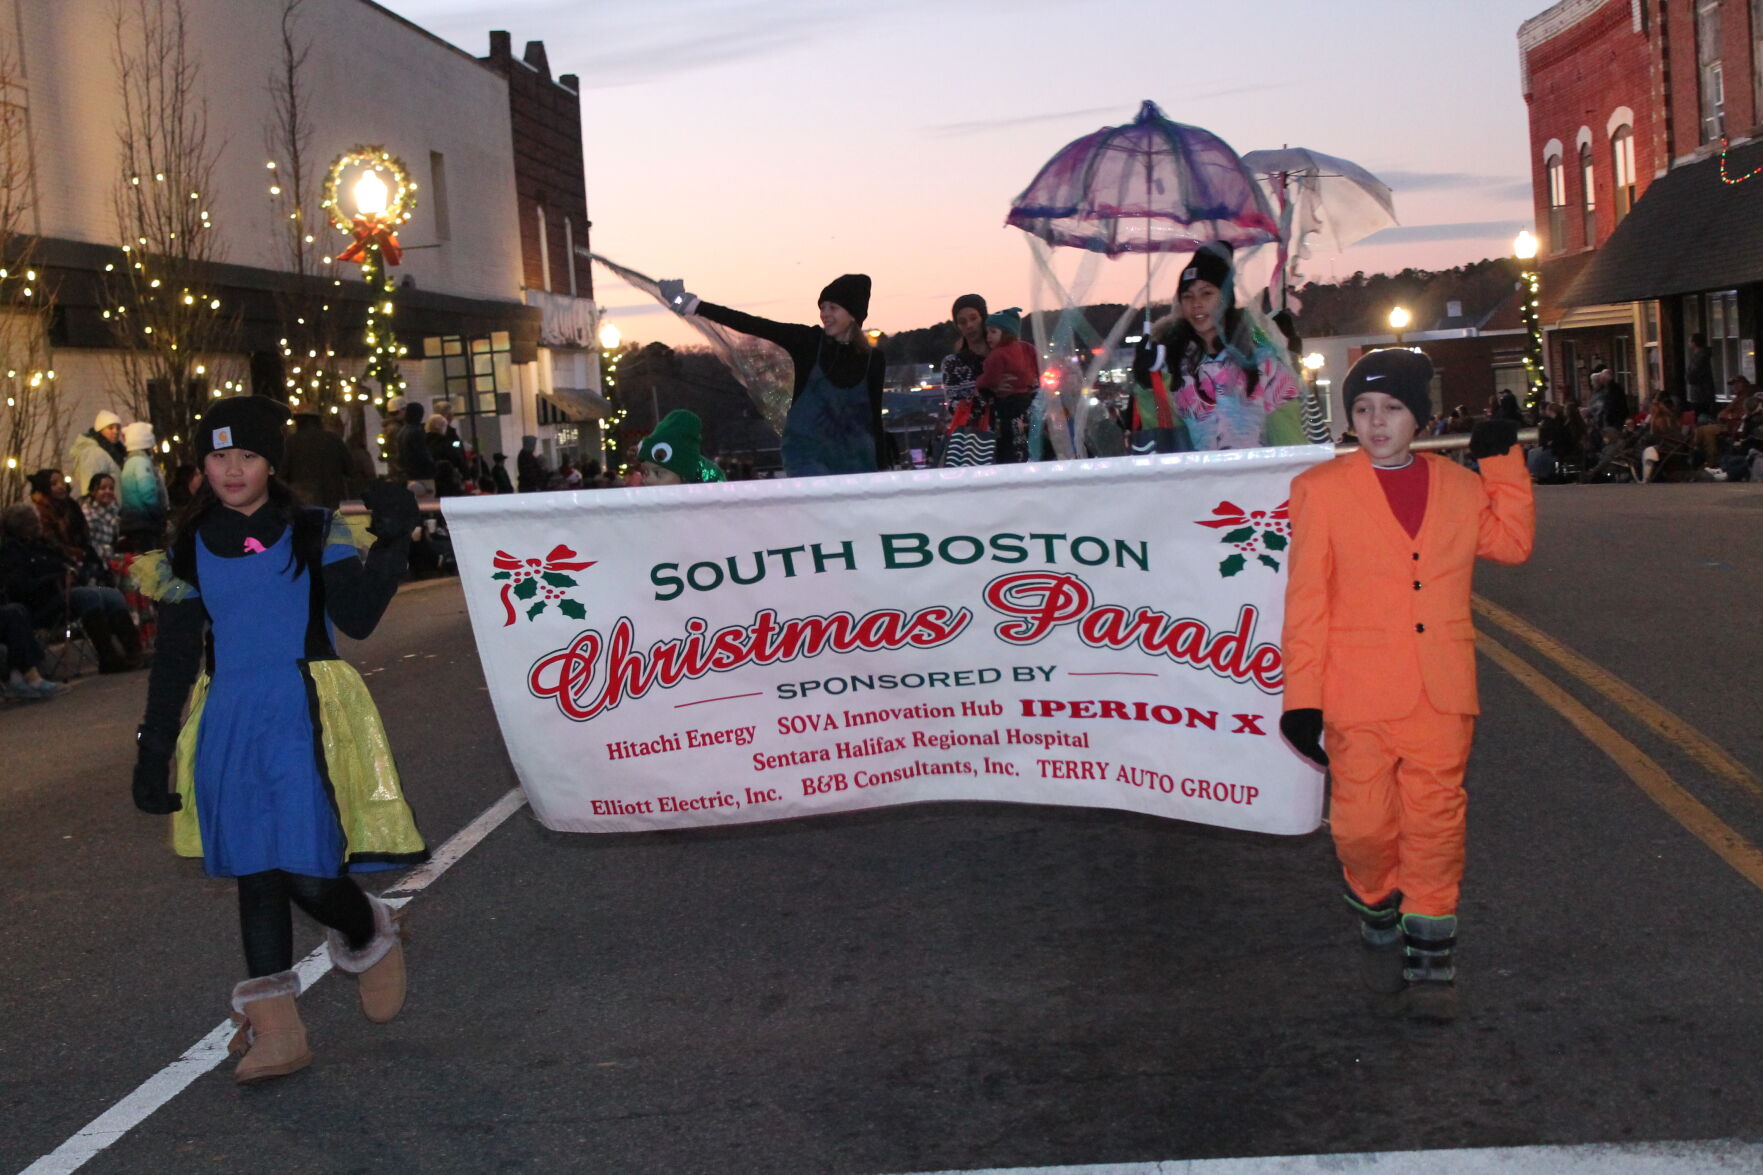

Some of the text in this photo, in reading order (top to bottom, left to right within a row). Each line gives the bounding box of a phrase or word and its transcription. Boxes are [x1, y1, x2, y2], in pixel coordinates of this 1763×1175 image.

[651, 532, 1149, 600] SOUTH BOSTON
[527, 571, 1283, 721] Christmas Parade
[777, 666, 1055, 699] SPONSORED BY
[778, 701, 1003, 734] SOVA Innovation Hub
[1020, 700, 1265, 735] IPERION X
[607, 726, 756, 760] Hitachi Energy
[753, 729, 1088, 770] Sentara Halifax Regional Hospital
[802, 758, 1019, 795] B&B Consultants, Inc.
[1037, 760, 1258, 804] TERRY AUTO GROUP
[591, 788, 782, 814] Elliott Electric, Inc.
